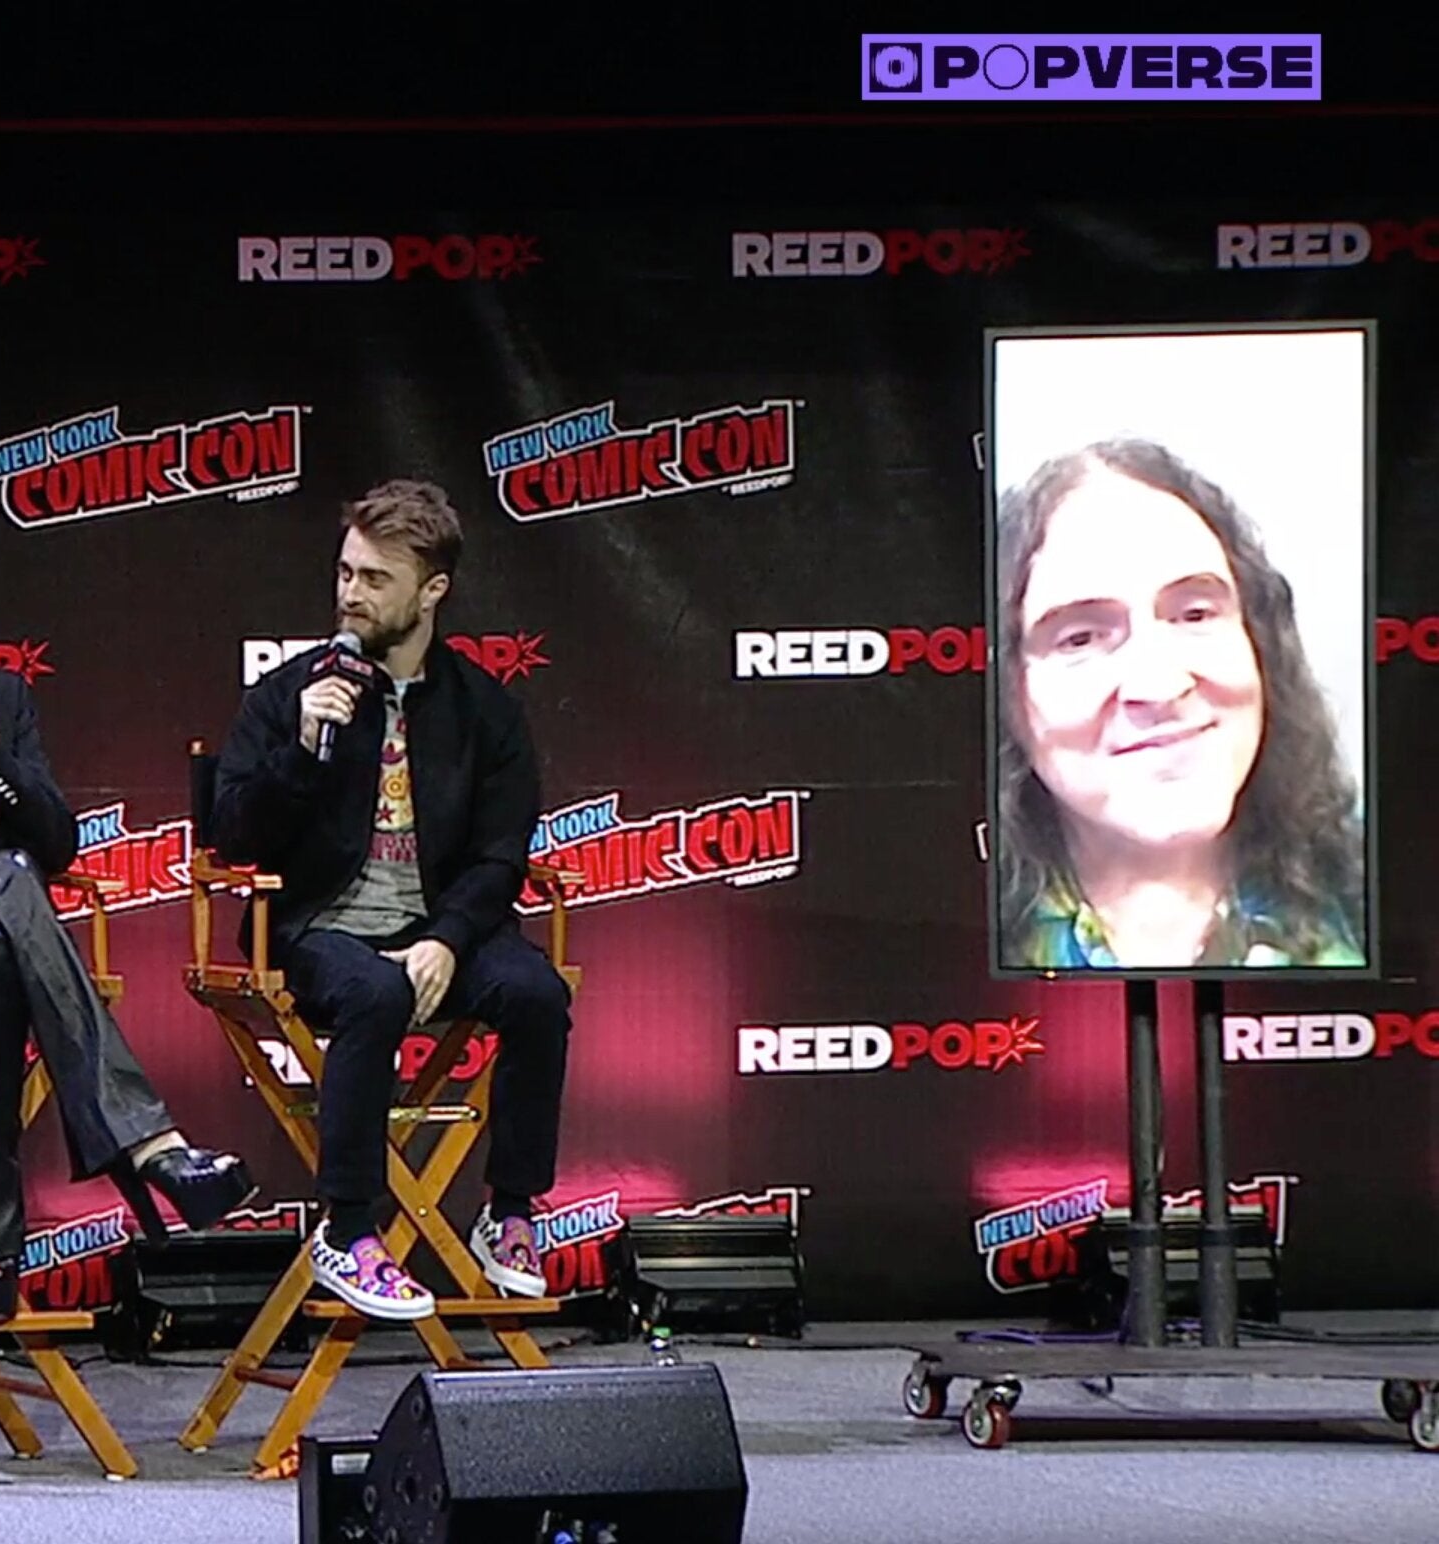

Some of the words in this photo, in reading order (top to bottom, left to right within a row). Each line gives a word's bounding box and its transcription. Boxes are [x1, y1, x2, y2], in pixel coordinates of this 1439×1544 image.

[238, 235, 513, 281] REEDPOP
[732, 228, 1004, 277] REEDPOP
[1217, 219, 1439, 269] REEDPO
[51, 414, 115, 455] YORK
[490, 431, 543, 469] NEW
[547, 409, 611, 449] YORK
[12, 435, 176, 517] COMIC
[189, 415, 292, 485] CON
[511, 430, 672, 511] COMIC
[684, 408, 785, 478] CON
[551, 803, 613, 841] YORK
[686, 801, 790, 870] CON
[739, 1023, 1012, 1073] REEDPOP
[1222, 1012, 1439, 1061] REEDPO
[55, 1220, 117, 1256] YORK
[551, 1200, 613, 1243] YORK
[982, 1211, 1033, 1246] NEW
[1040, 1187, 1102, 1226] YORK
